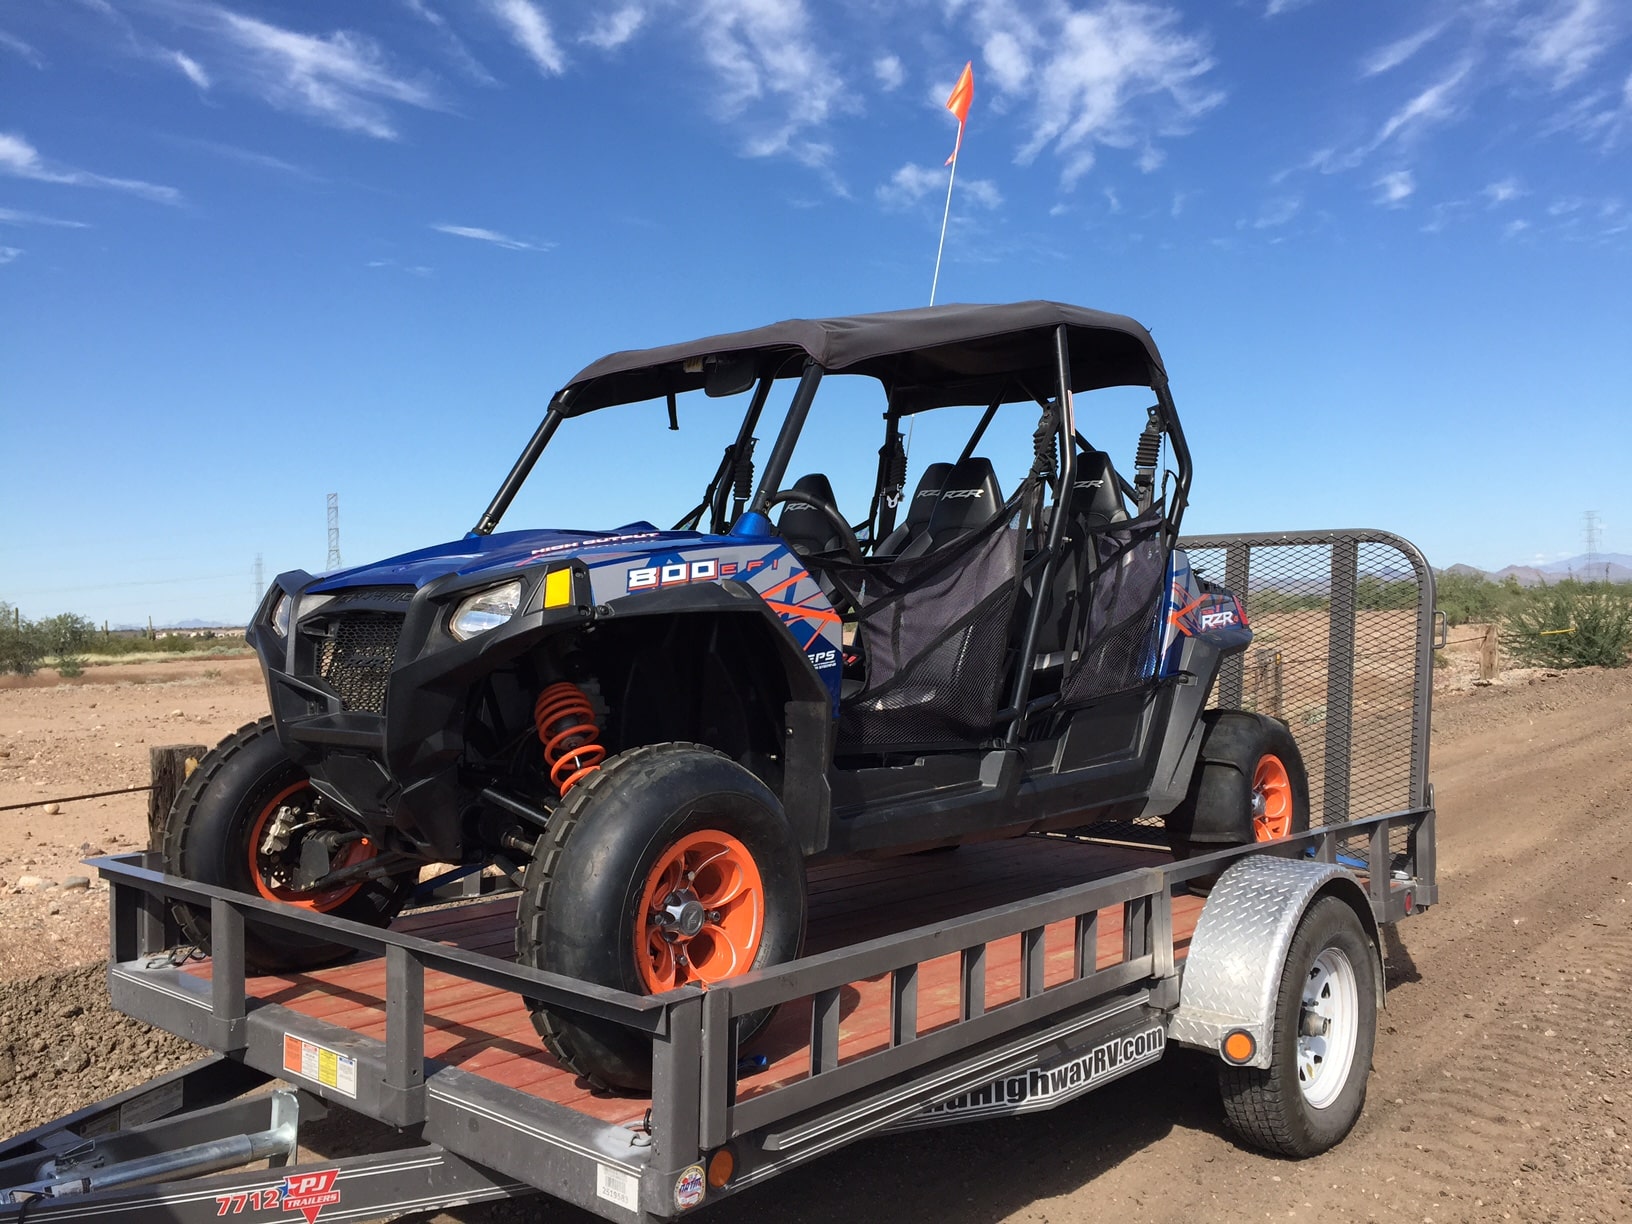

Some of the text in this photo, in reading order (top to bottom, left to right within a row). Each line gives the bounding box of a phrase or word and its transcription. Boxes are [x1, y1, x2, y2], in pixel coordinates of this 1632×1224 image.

[1073, 480, 1104, 489] ZR
[941, 489, 984, 501] RZR
[531, 542, 579, 555] HIGH
[582, 532, 660, 545] OUTPUT
[628, 558, 719, 591] 800
[1201, 611, 1235, 631] RZR
[298, 1175, 328, 1193] PJ
[216, 1188, 280, 1216] 7712
[286, 1193, 337, 1208] TRAILERS
